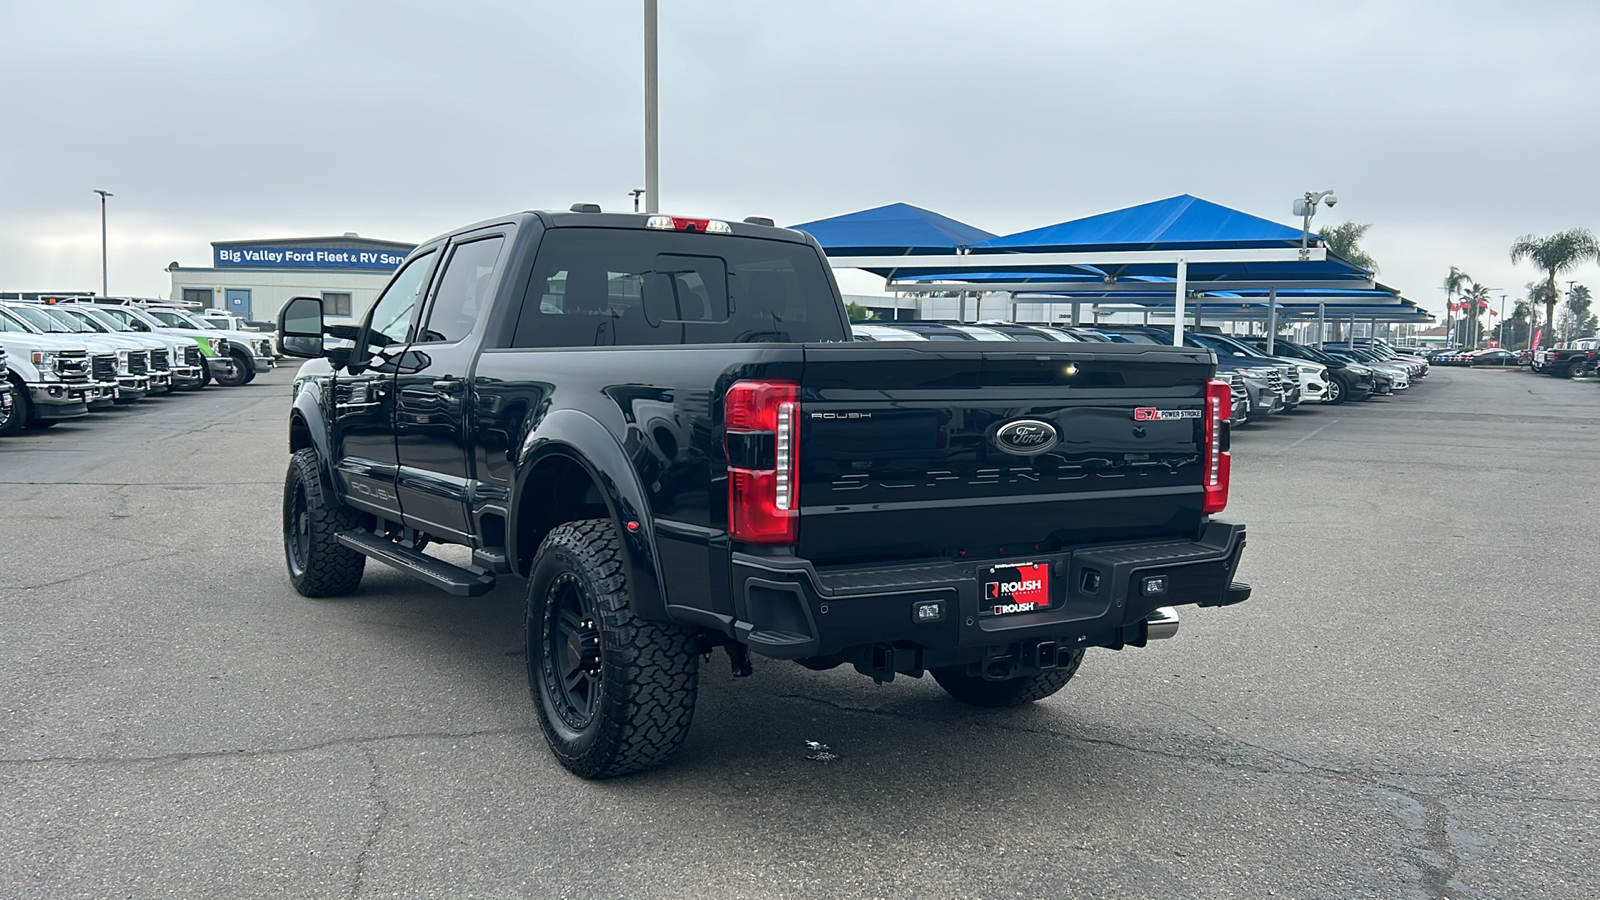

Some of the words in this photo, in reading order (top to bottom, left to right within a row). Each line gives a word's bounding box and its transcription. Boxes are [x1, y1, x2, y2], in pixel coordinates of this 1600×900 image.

[219, 249, 242, 263] Big
[243, 250, 283, 263] Valley
[285, 250, 314, 262] Ford
[316, 251, 349, 263] Fleet
[350, 255, 358, 263] &
[360, 252, 378, 264] RV
[1180, 410, 1201, 418] STROKE
[1012, 426, 1045, 444] Ford
[831, 467, 1041, 491] SUPER
[351, 481, 398, 503] ROUSH
[1001, 580, 1041, 592] ROUSH
[1002, 602, 1034, 613] ROUSH
